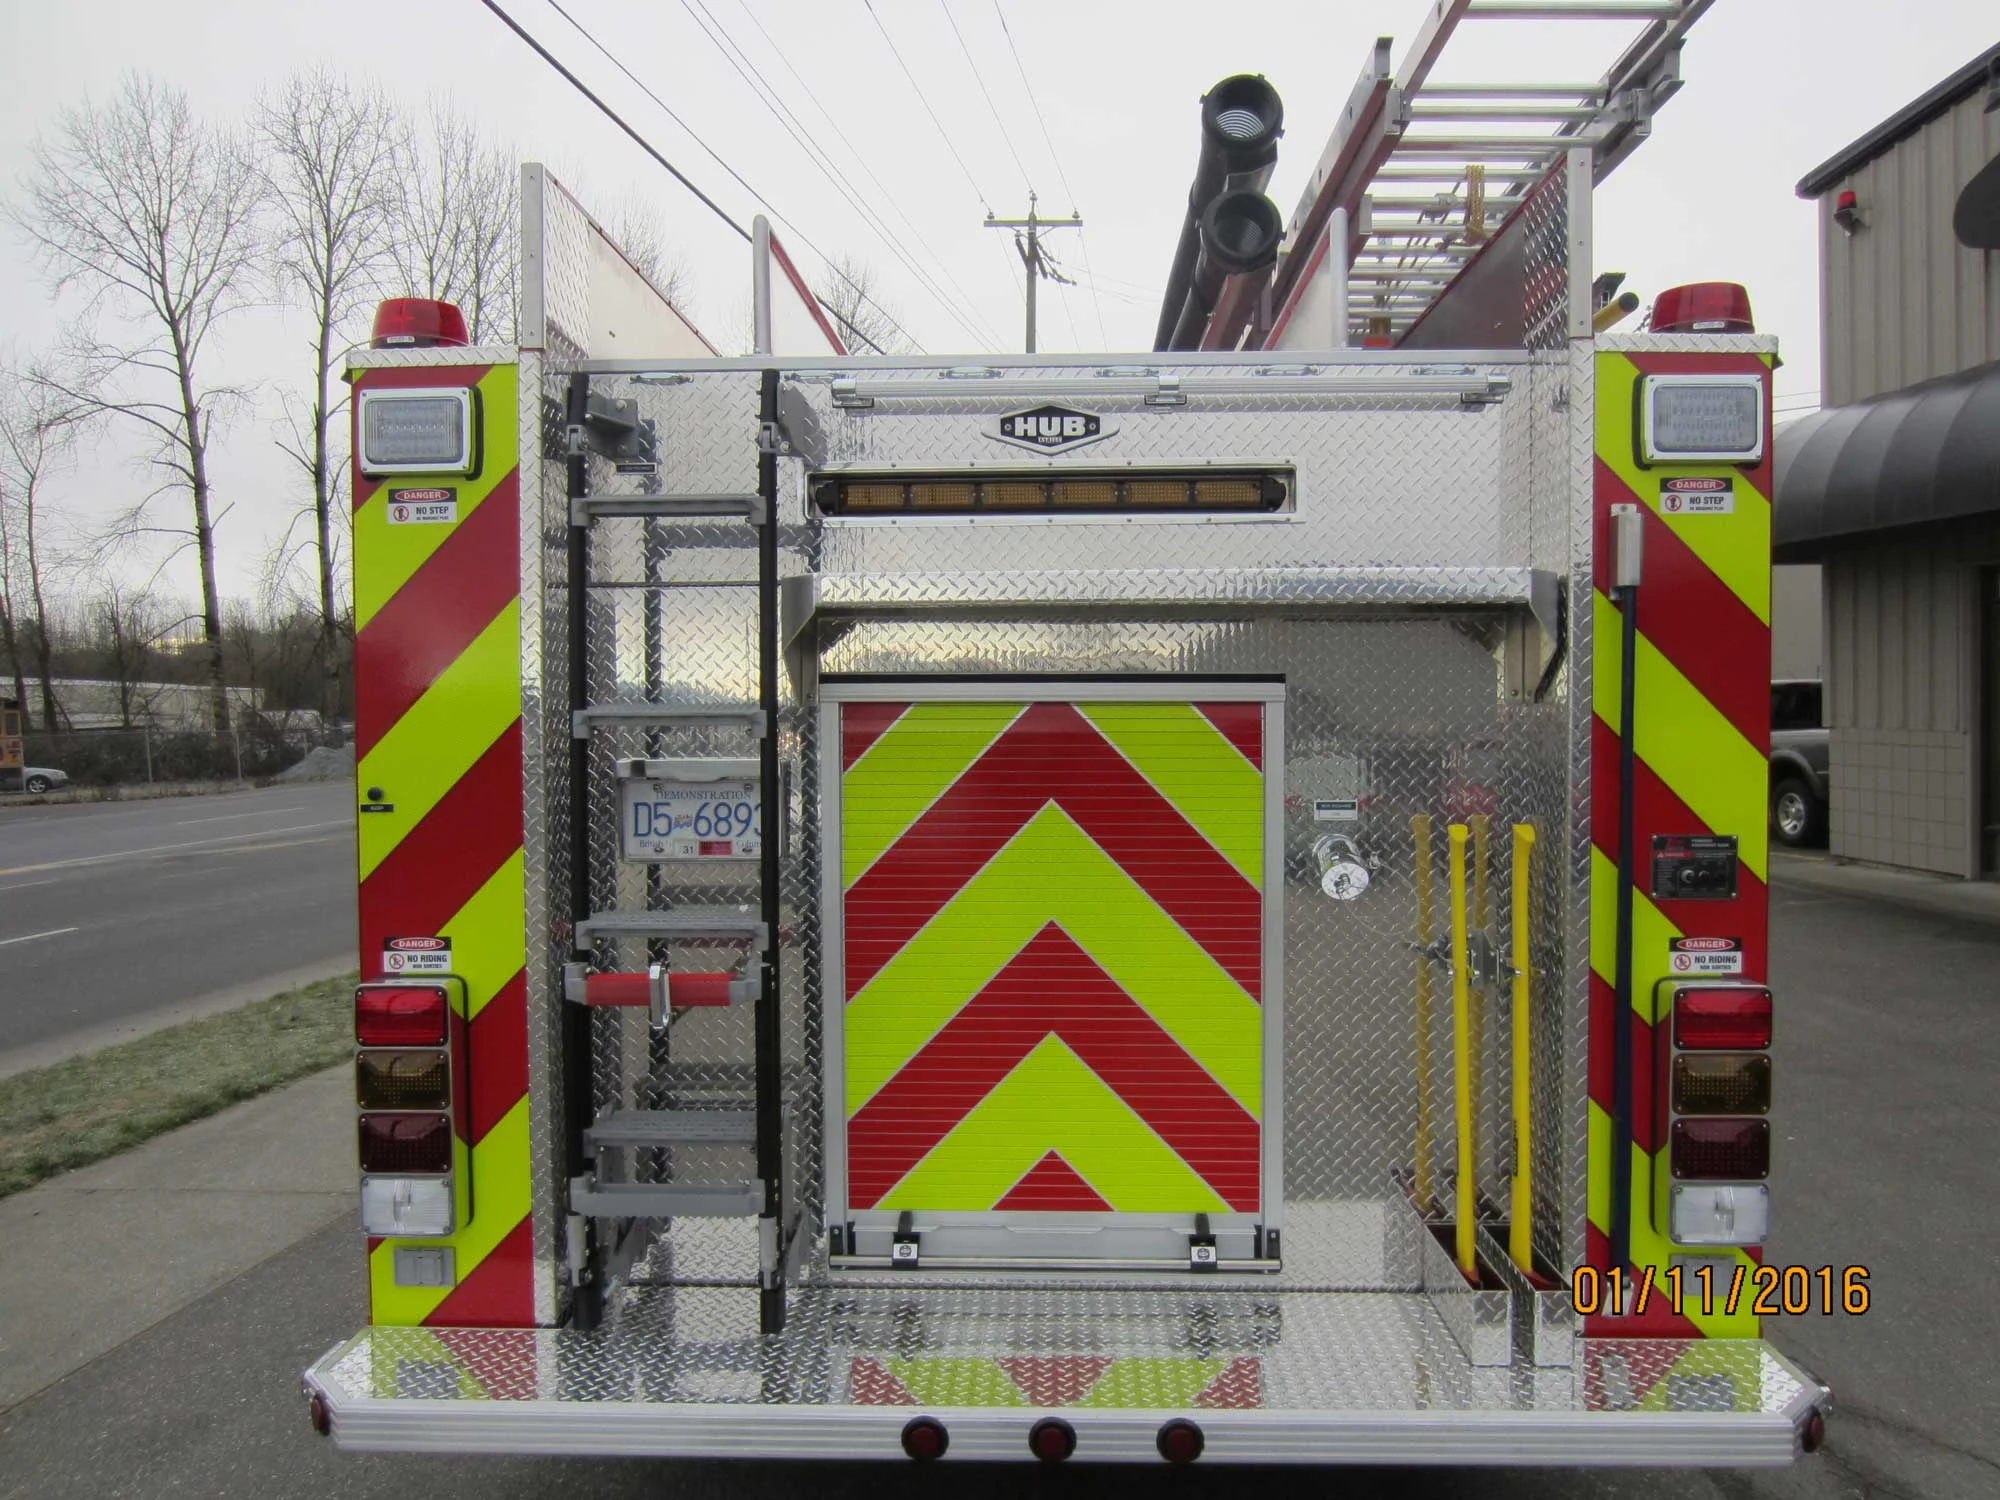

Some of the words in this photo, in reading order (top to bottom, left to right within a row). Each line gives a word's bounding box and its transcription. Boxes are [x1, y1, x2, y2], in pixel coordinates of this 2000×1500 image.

[1014, 416, 1086, 437] HUB
[1676, 481, 1716, 489] DANGER
[403, 491, 441, 499] DANGER
[1689, 496, 1701, 504] NO
[1704, 496, 1724, 504] STEP
[416, 506, 427, 515] NO
[429, 506, 449, 514] STEP
[655, 790, 752, 801] DEMONSTRATION
[633, 802, 673, 837] D5
[639, 839, 664, 848] British
[682, 845, 694, 854] 31
[398, 940, 436, 948] DANGER
[1685, 940, 1726, 948] DANGER
[407, 954, 418, 962] NO
[421, 954, 447, 962] RIDING
[1694, 955, 1706, 963] NO
[1709, 955, 1737, 963] RIDING
